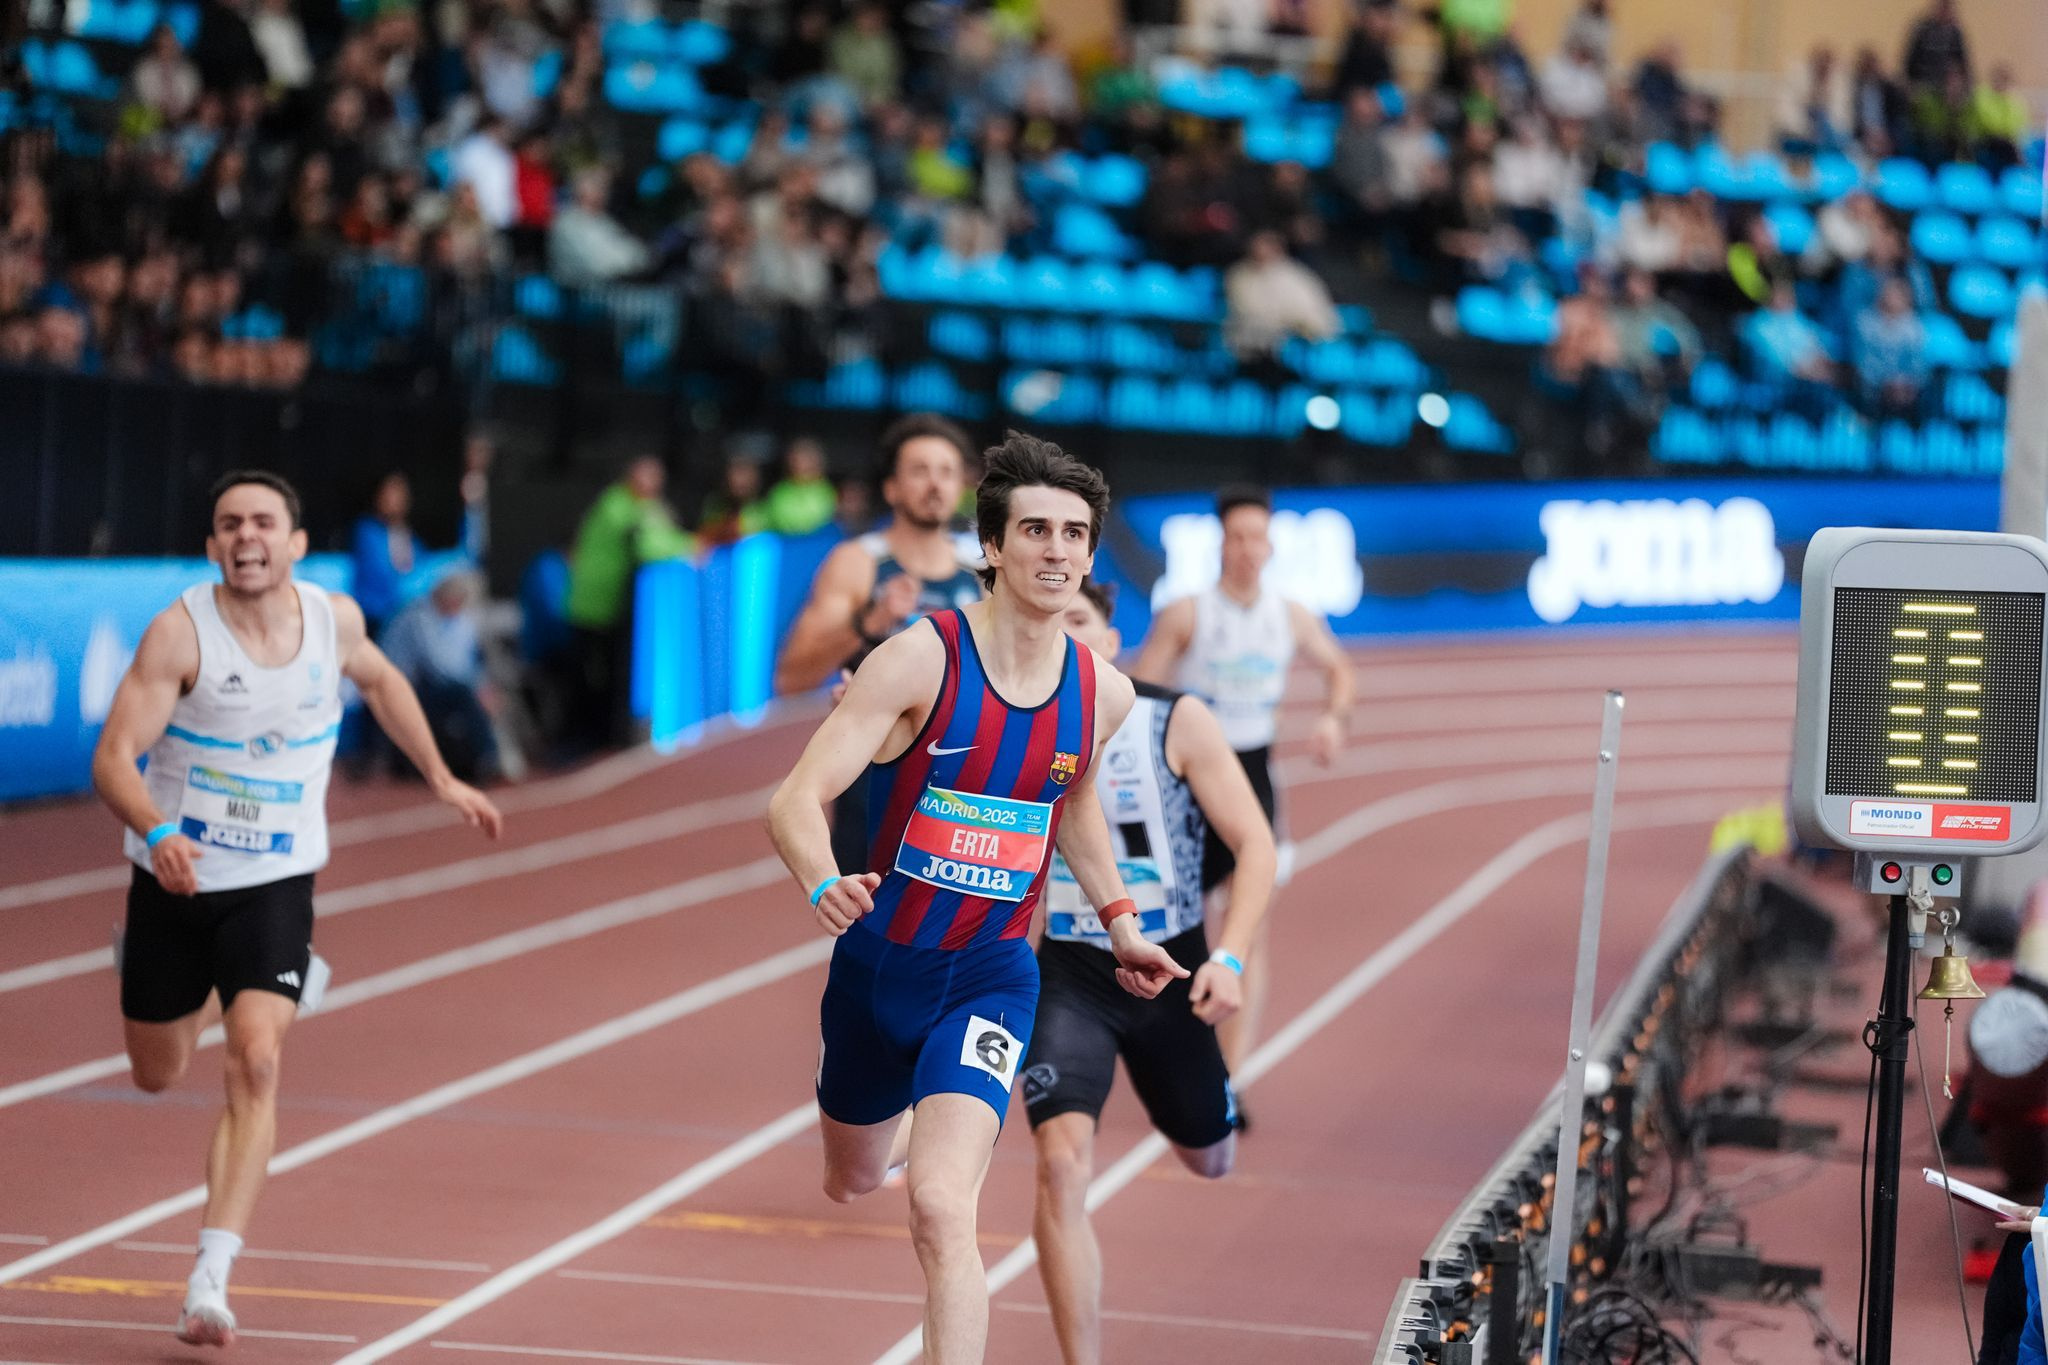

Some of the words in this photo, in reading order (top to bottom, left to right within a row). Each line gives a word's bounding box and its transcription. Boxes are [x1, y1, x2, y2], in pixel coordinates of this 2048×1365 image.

[919, 796, 980, 820] MADRID
[982, 807, 1017, 826] 2025
[1871, 809, 1922, 820] MONDO
[950, 828, 1000, 860] ERTA
[922, 856, 1012, 892] Joma
[975, 1030, 1009, 1074] 6
